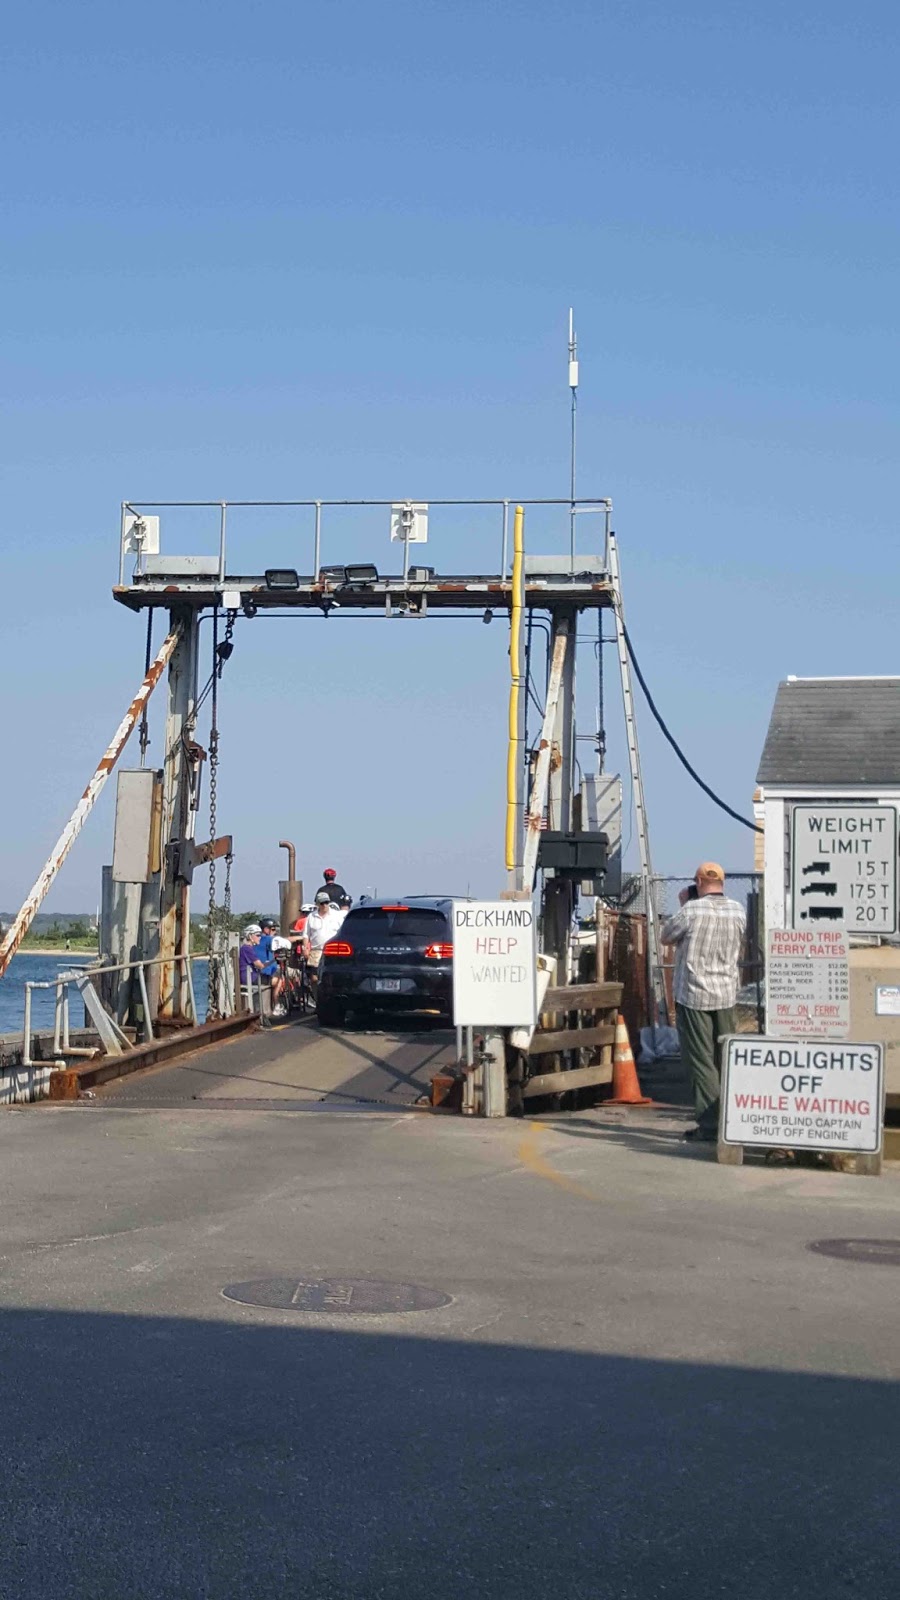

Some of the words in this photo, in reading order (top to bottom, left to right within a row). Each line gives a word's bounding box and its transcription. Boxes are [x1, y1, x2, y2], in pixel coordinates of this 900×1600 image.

[808, 817, 886, 832] WEIGHT
[818, 839, 872, 854] LIMIT
[858, 861, 875, 876] 15
[881, 861, 889, 876] T
[881, 884, 889, 899] T
[456, 910, 533, 927] DECKHAND
[856, 906, 876, 921] 20
[881, 906, 889, 921] T
[774, 932, 814, 942] ROUND
[816, 932, 842, 942] TRIP
[476, 937, 518, 955] HELP
[771, 944, 806, 955] FERRY
[809, 945, 846, 955] RATES
[470, 965, 528, 983] WANTED
[777, 1004, 790, 1015] PAY
[797, 1005, 808, 1016] ON
[814, 1005, 840, 1016] FERRY
[734, 1048, 873, 1072] HEADLIGHTS
[781, 1074, 823, 1094] OFF
[734, 1094, 789, 1111] WHILE
[794, 1096, 870, 1116] WAITING
[741, 1114, 778, 1125] LIGHTS
[781, 1117, 813, 1127] BLIND
[815, 1118, 862, 1130] CAPTAIN
[752, 1126, 780, 1137] SHUT
[784, 1127, 804, 1138] OFF
[807, 1129, 848, 1141] ENGINE
